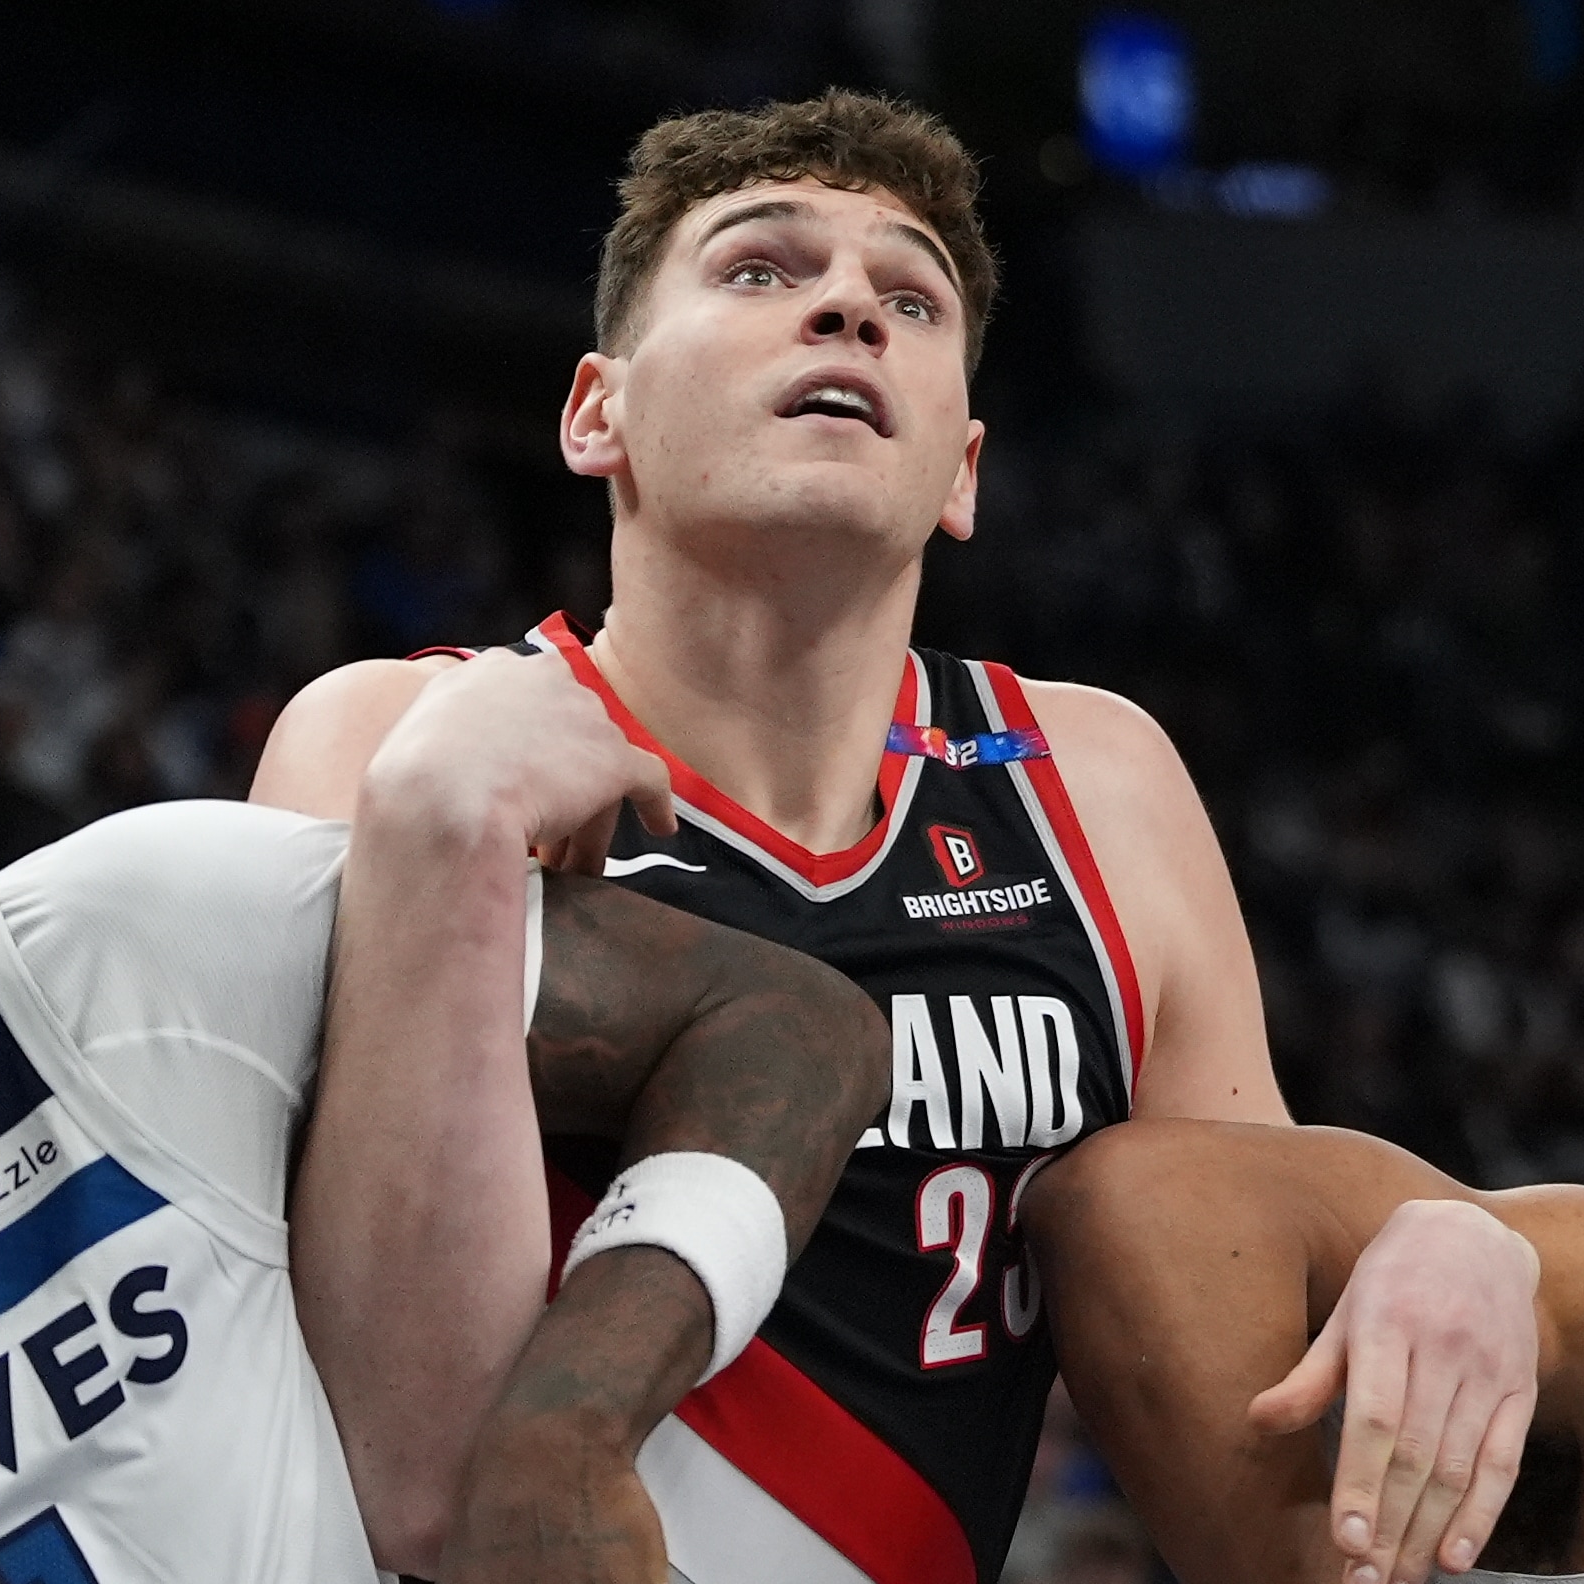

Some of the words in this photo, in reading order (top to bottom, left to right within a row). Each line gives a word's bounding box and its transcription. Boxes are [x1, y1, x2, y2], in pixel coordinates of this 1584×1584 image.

[944, 739, 978, 767] 32
[945, 836, 975, 876] B
[902, 878, 1052, 919] BRIGHTSIDE
[855, 994, 1084, 1150] AND
